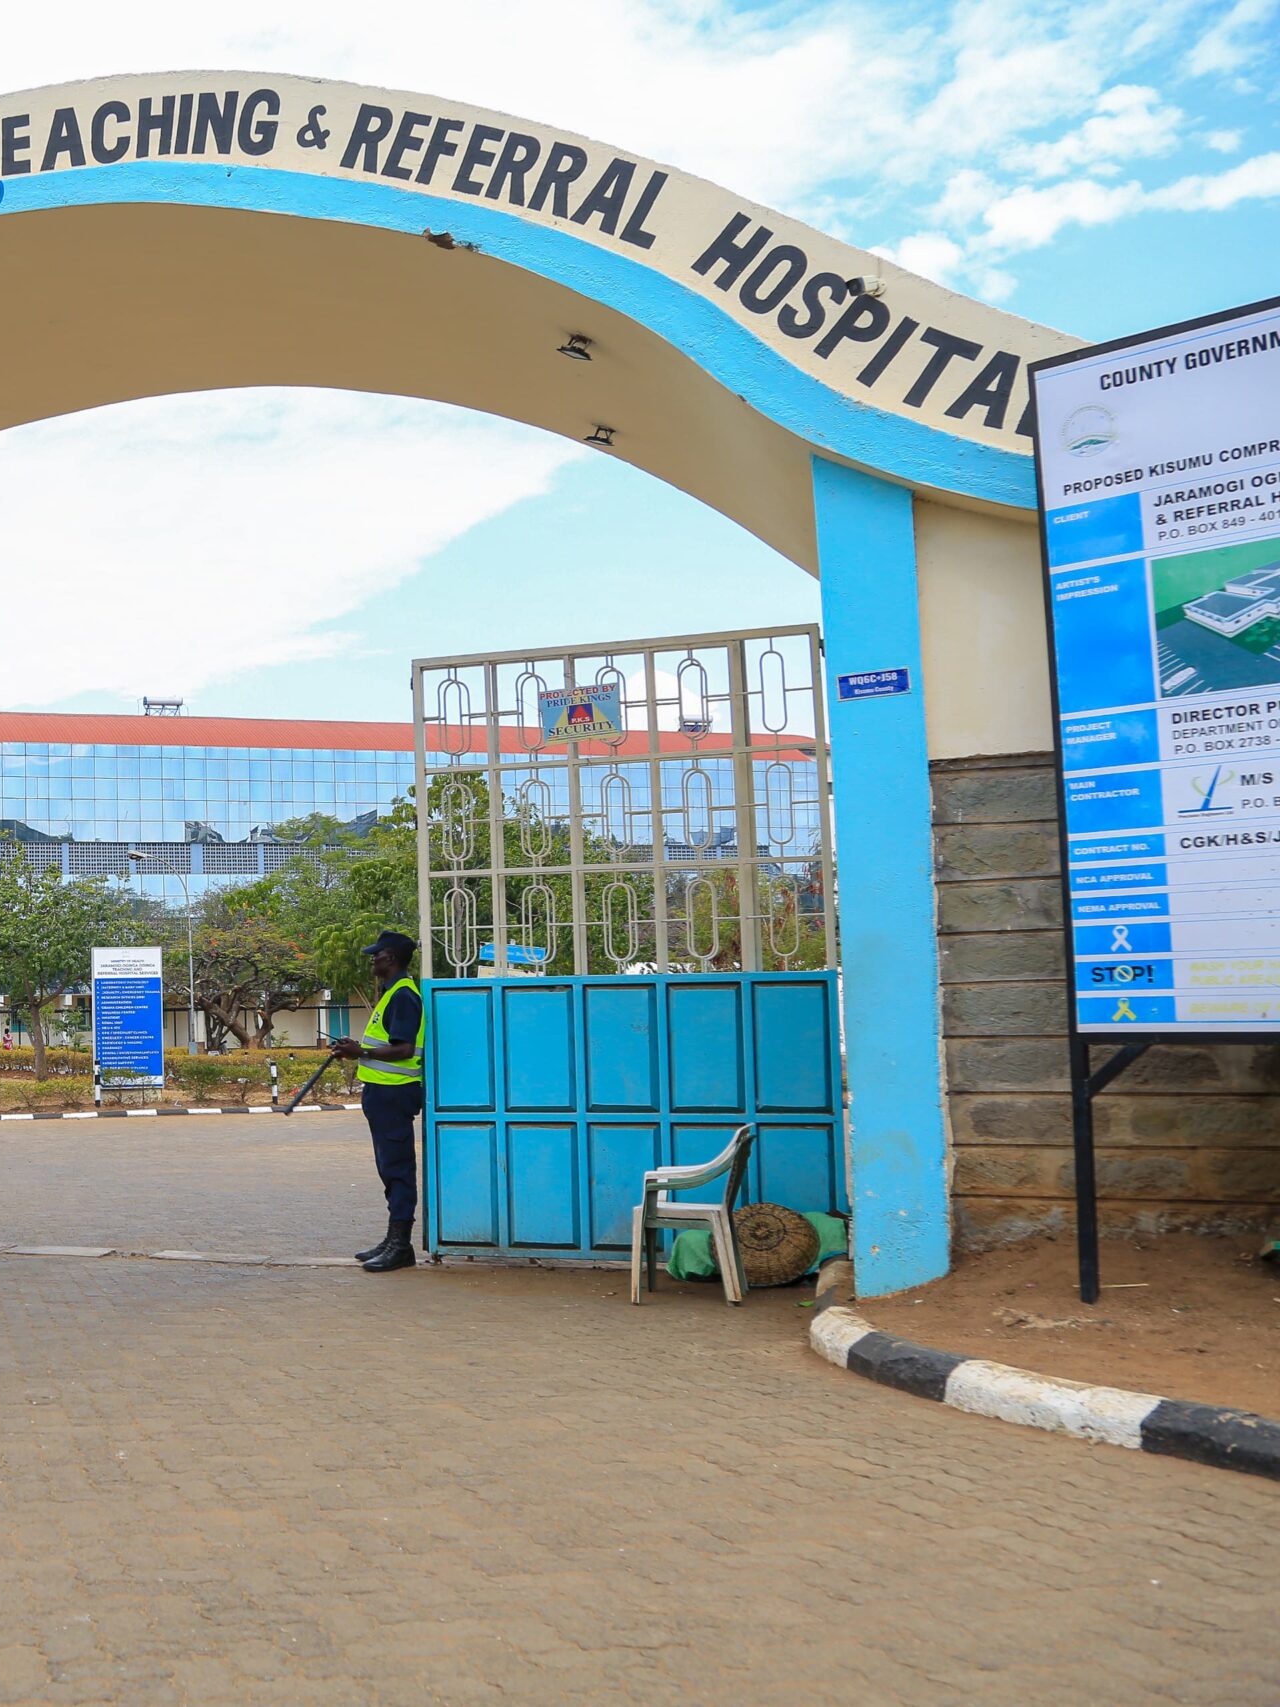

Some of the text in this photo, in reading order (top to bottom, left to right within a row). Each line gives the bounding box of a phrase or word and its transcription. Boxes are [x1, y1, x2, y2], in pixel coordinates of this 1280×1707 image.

[295, 104, 330, 150] &
[340, 102, 669, 250] REFERRAL
[691, 211, 1035, 438] HOSPITA
[1100, 356, 1178, 392] COUNTY
[1063, 468, 1144, 496] PROPOSED
[1149, 453, 1213, 478] KISUMU
[1153, 478, 1245, 507] JARAMOGI
[1053, 511, 1090, 524] CLIENT
[1155, 513, 1167, 526] &
[1174, 494, 1265, 523] REFERRAL
[1158, 527, 1184, 541] P.O.
[1188, 521, 1218, 536] BOX
[1222, 515, 1246, 529] 849
[1056, 575, 1101, 591] ARTIST'S
[1056, 584, 1119, 602] IMPRESSION
[602, 684, 616, 693] BY
[547, 692, 612, 708] PRIDE KINGS
[1171, 701, 1280, 725] DIRECTOR P
[549, 721, 613, 736] SECURITY
[1066, 721, 1112, 734] PROJECT
[1172, 718, 1280, 740] DEPARTMENT O
[1066, 732, 1117, 745] MANAGER
[1174, 743, 1200, 755] P.O.
[1204, 738, 1234, 752] BOX
[1239, 735, 1271, 748] 2738
[1069, 780, 1096, 790] MAIN
[1240, 772, 1274, 787] M/S
[1071, 788, 1140, 801] CONTRACTOR
[1241, 797, 1269, 809] P.O.
[1074, 842, 1151, 856] CONTRACT NO.
[1076, 872, 1155, 885] NCA APPROVAL
[1077, 901, 1162, 913] NEMA APPROVAL
